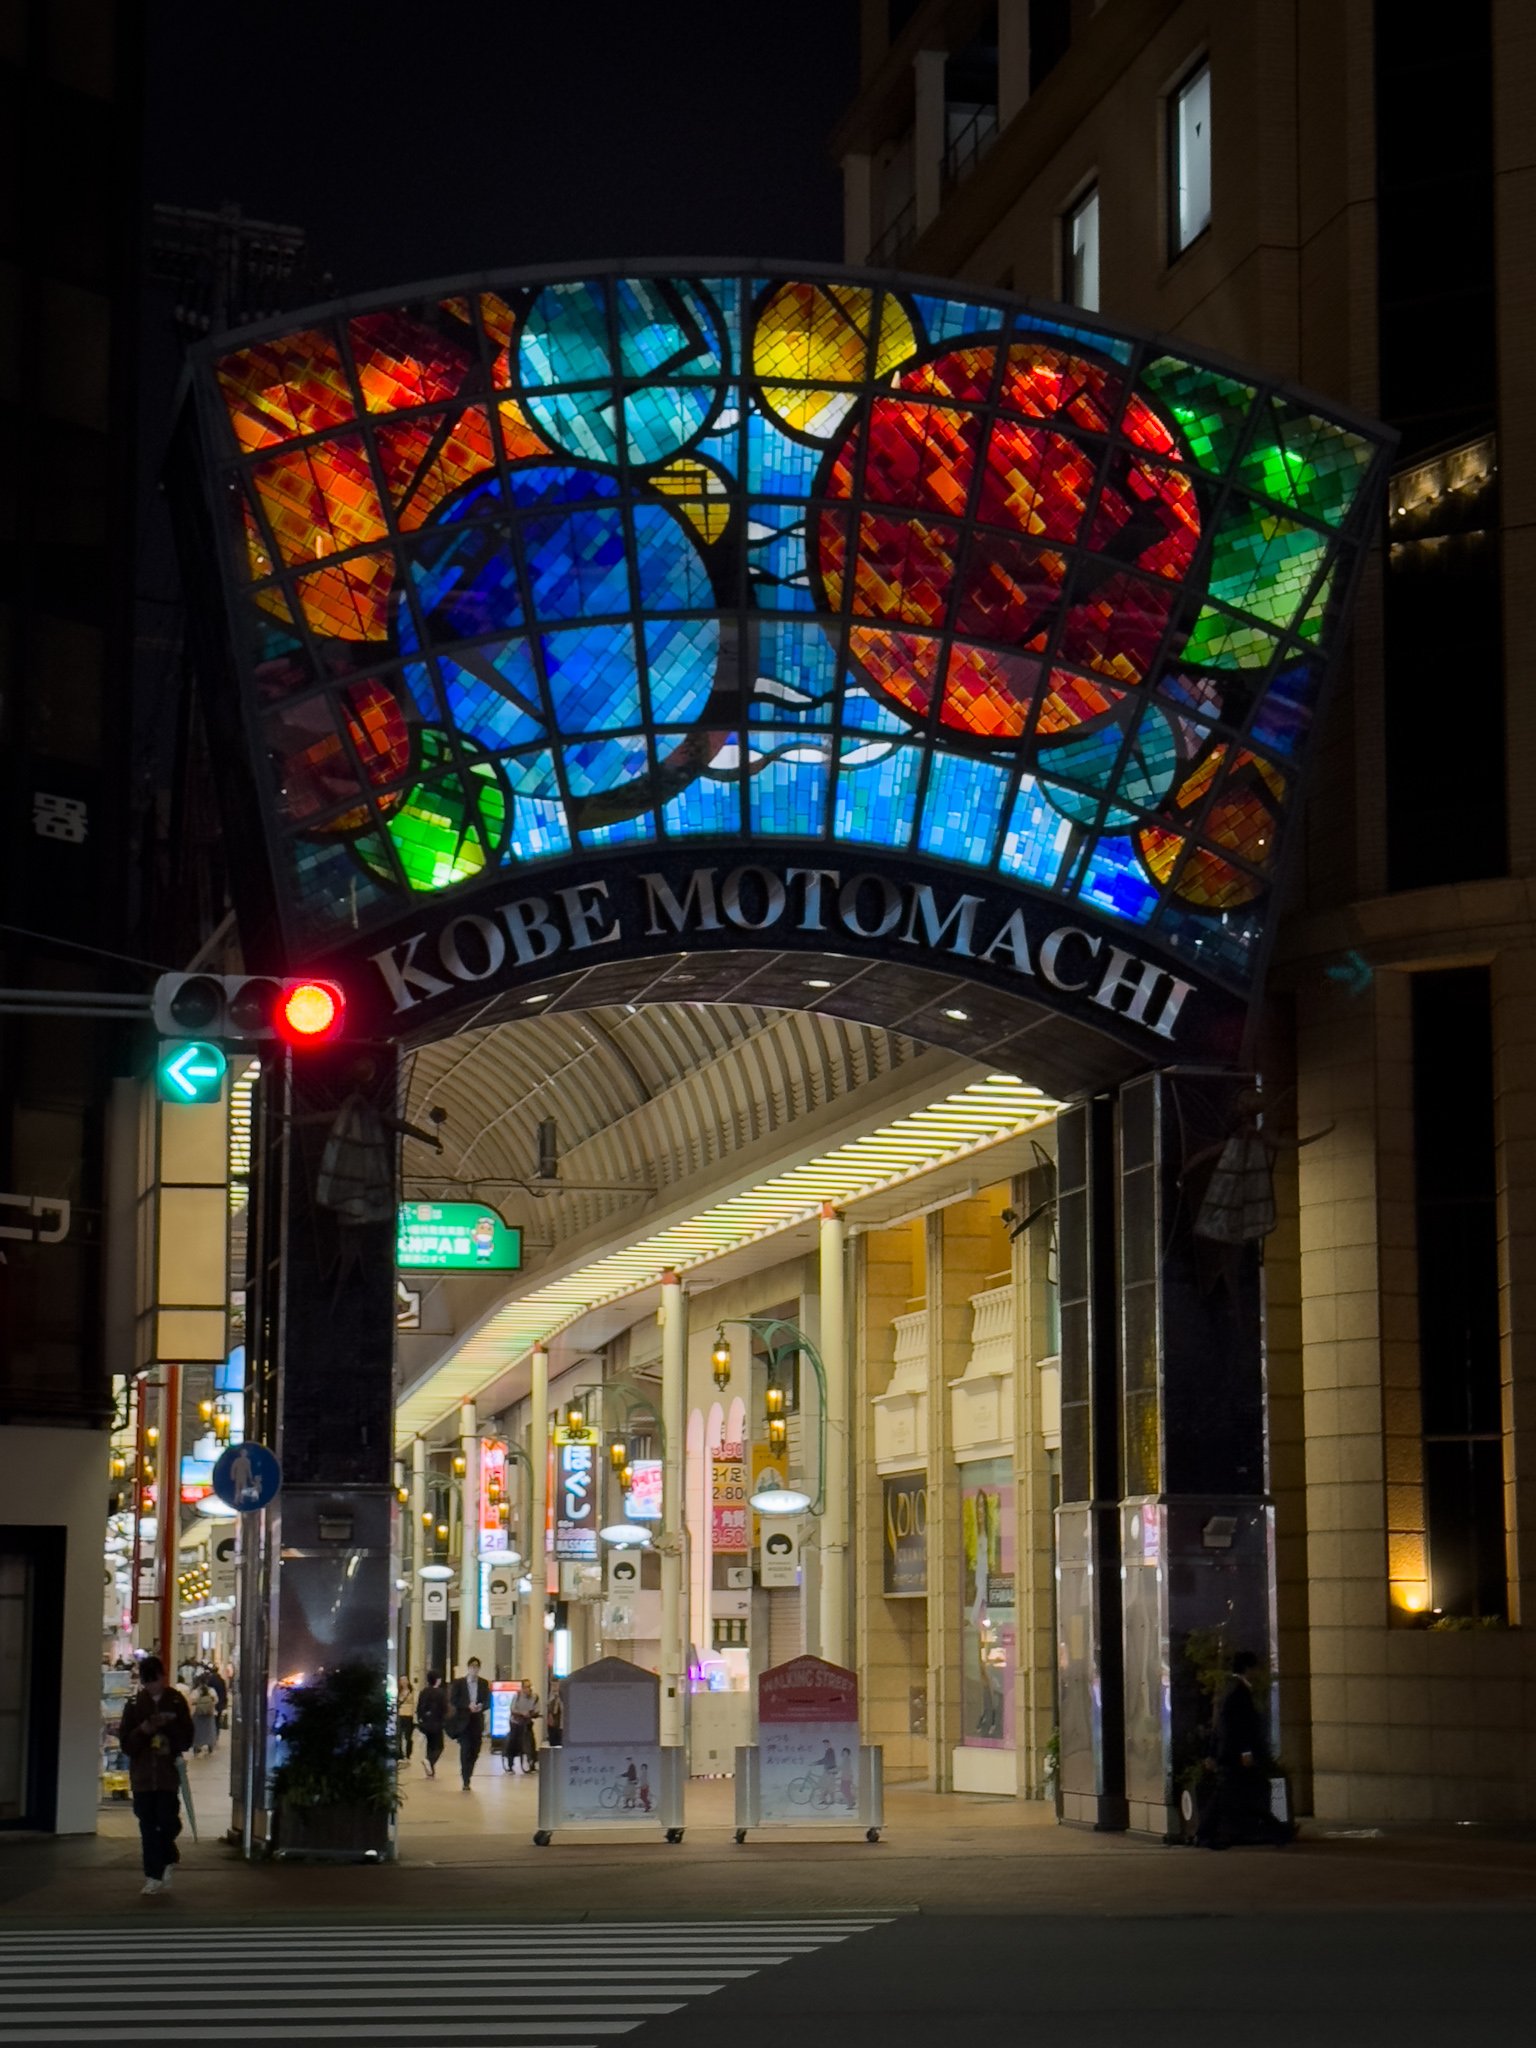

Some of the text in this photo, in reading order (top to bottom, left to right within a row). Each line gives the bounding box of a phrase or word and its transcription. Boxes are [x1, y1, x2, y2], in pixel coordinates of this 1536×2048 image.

[370, 865, 1199, 1042] KOBE MOTOMACHI
[563, 1445, 592, 1519] ほぐし
[484, 1534, 504, 1548] 2F
[762, 1669, 856, 1692] WALKING STREET
